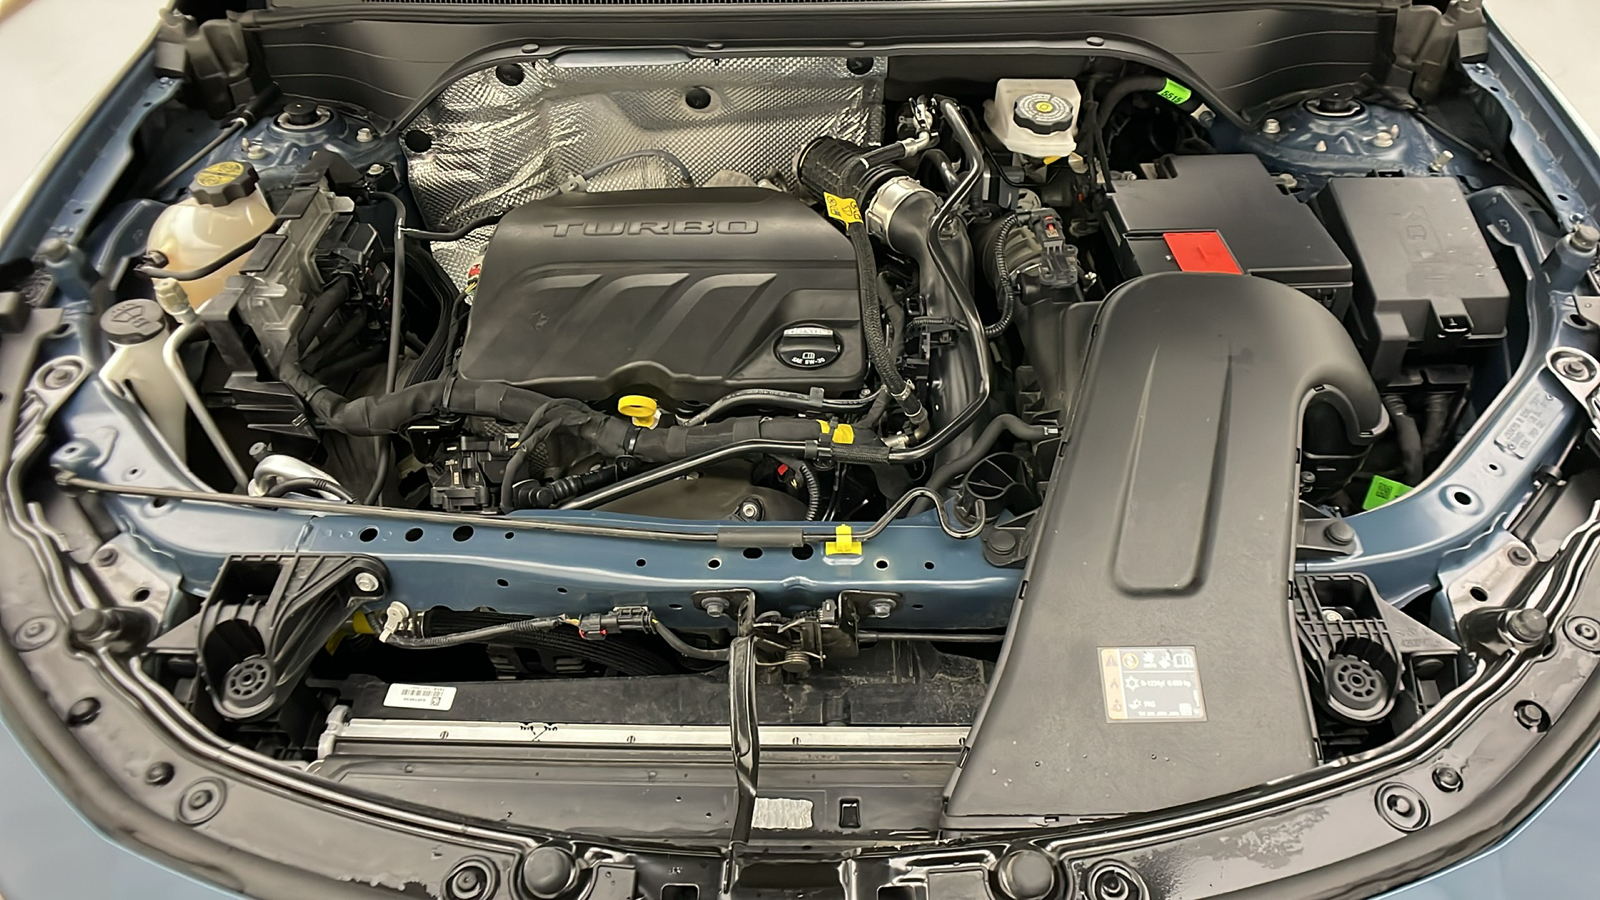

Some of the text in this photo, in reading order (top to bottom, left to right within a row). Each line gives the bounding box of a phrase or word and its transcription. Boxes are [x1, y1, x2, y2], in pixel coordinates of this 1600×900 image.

[1161, 90, 1183, 103] 5515
[542, 219, 759, 238] TURBO
[791, 356, 826, 365] SAE 5W-30
